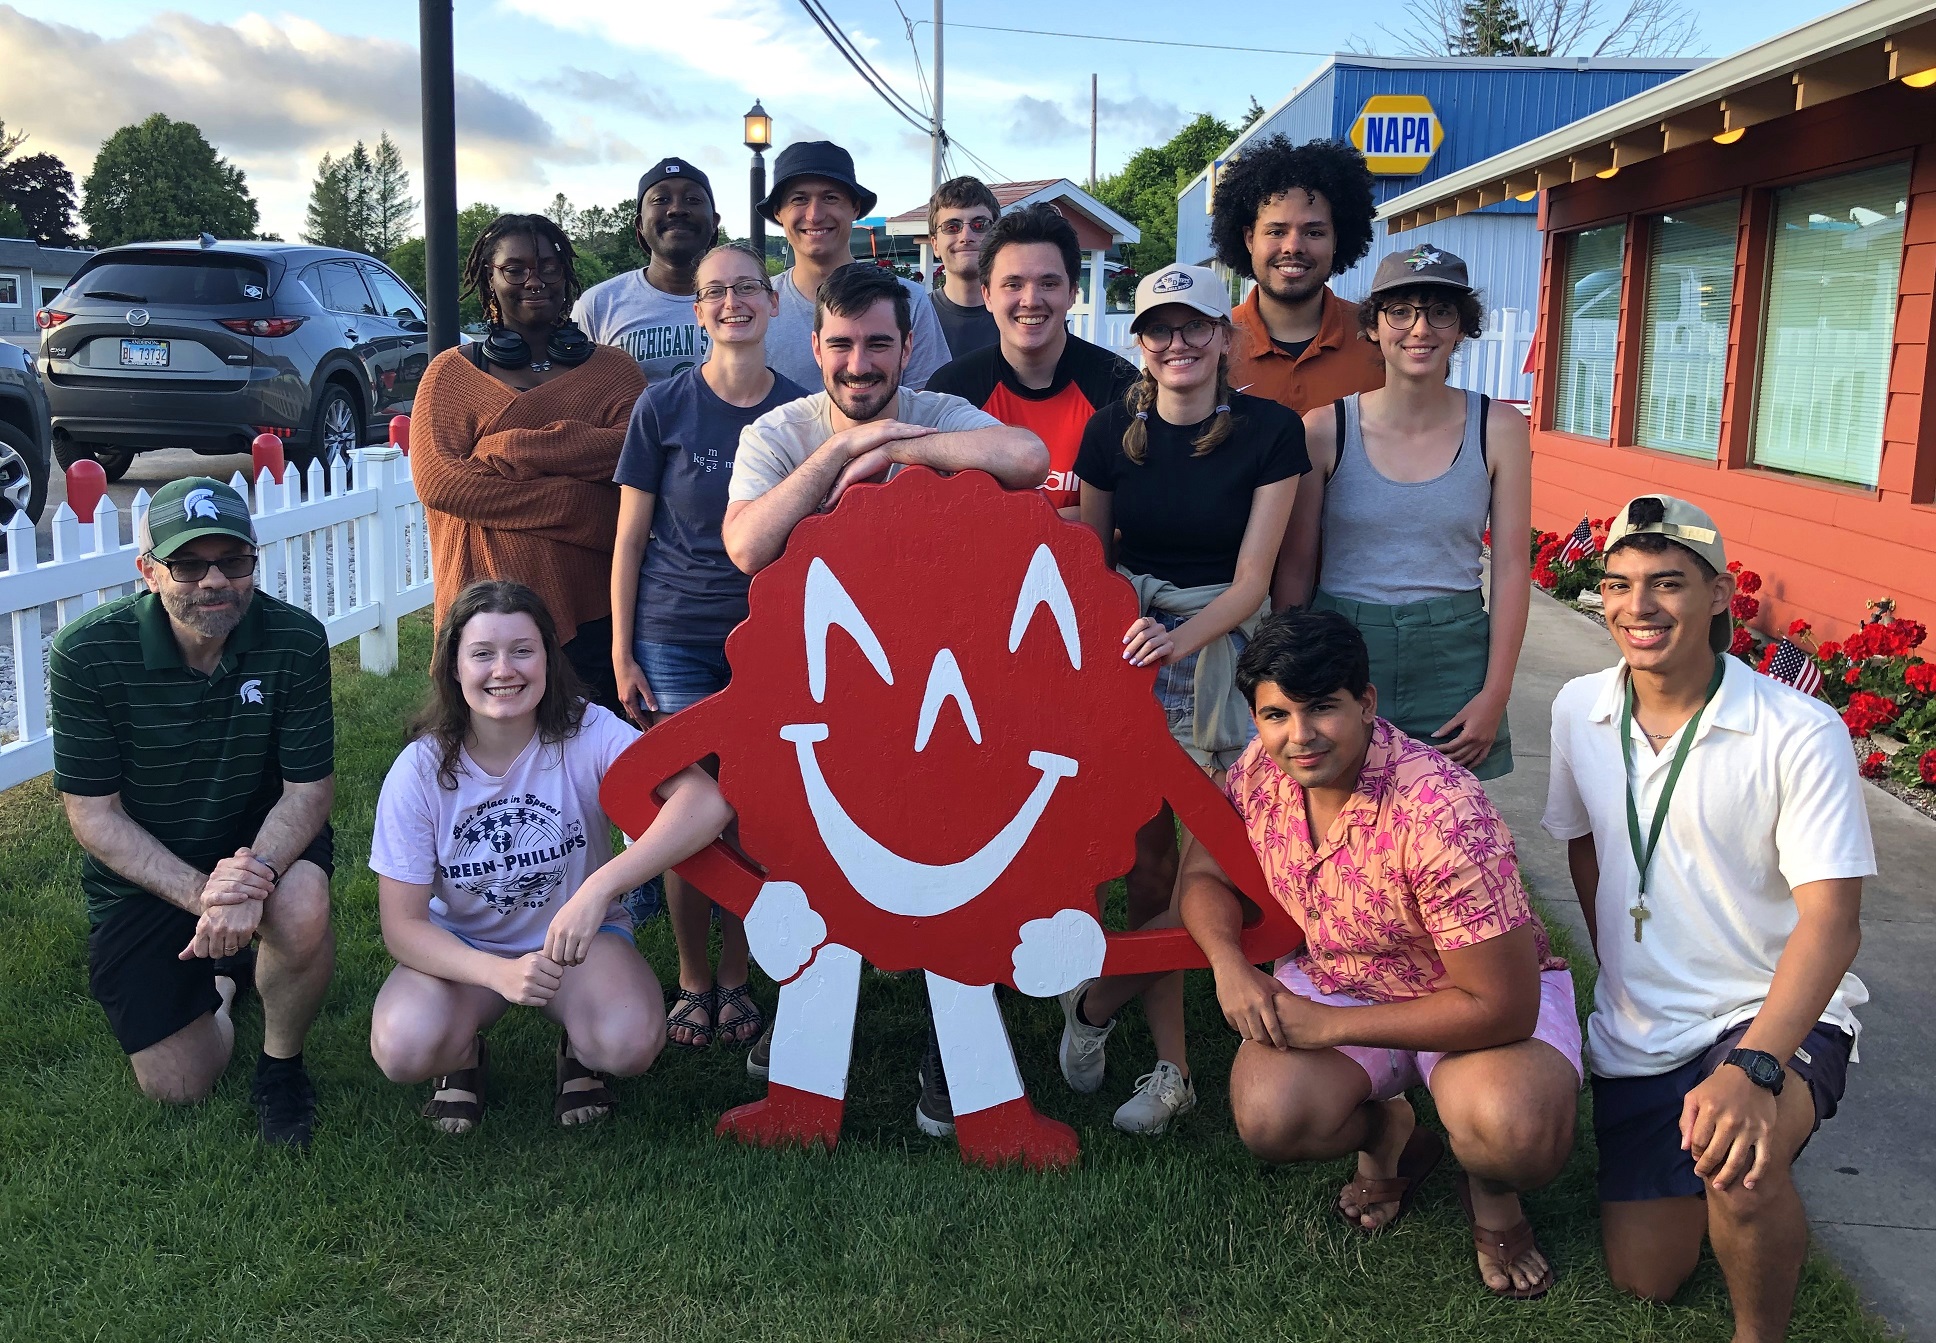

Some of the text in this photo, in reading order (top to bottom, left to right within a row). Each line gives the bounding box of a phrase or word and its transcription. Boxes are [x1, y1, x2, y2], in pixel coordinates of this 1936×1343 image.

[1367, 117, 1431, 154] NAPA
[122, 347, 167, 361] BL 73732
[620, 324, 695, 361] MICHIGAN
[693, 452, 705, 467] kg
[453, 793, 562, 840] Best Place in Space!
[440, 834, 587, 879] BREEN-PHILLIPS
